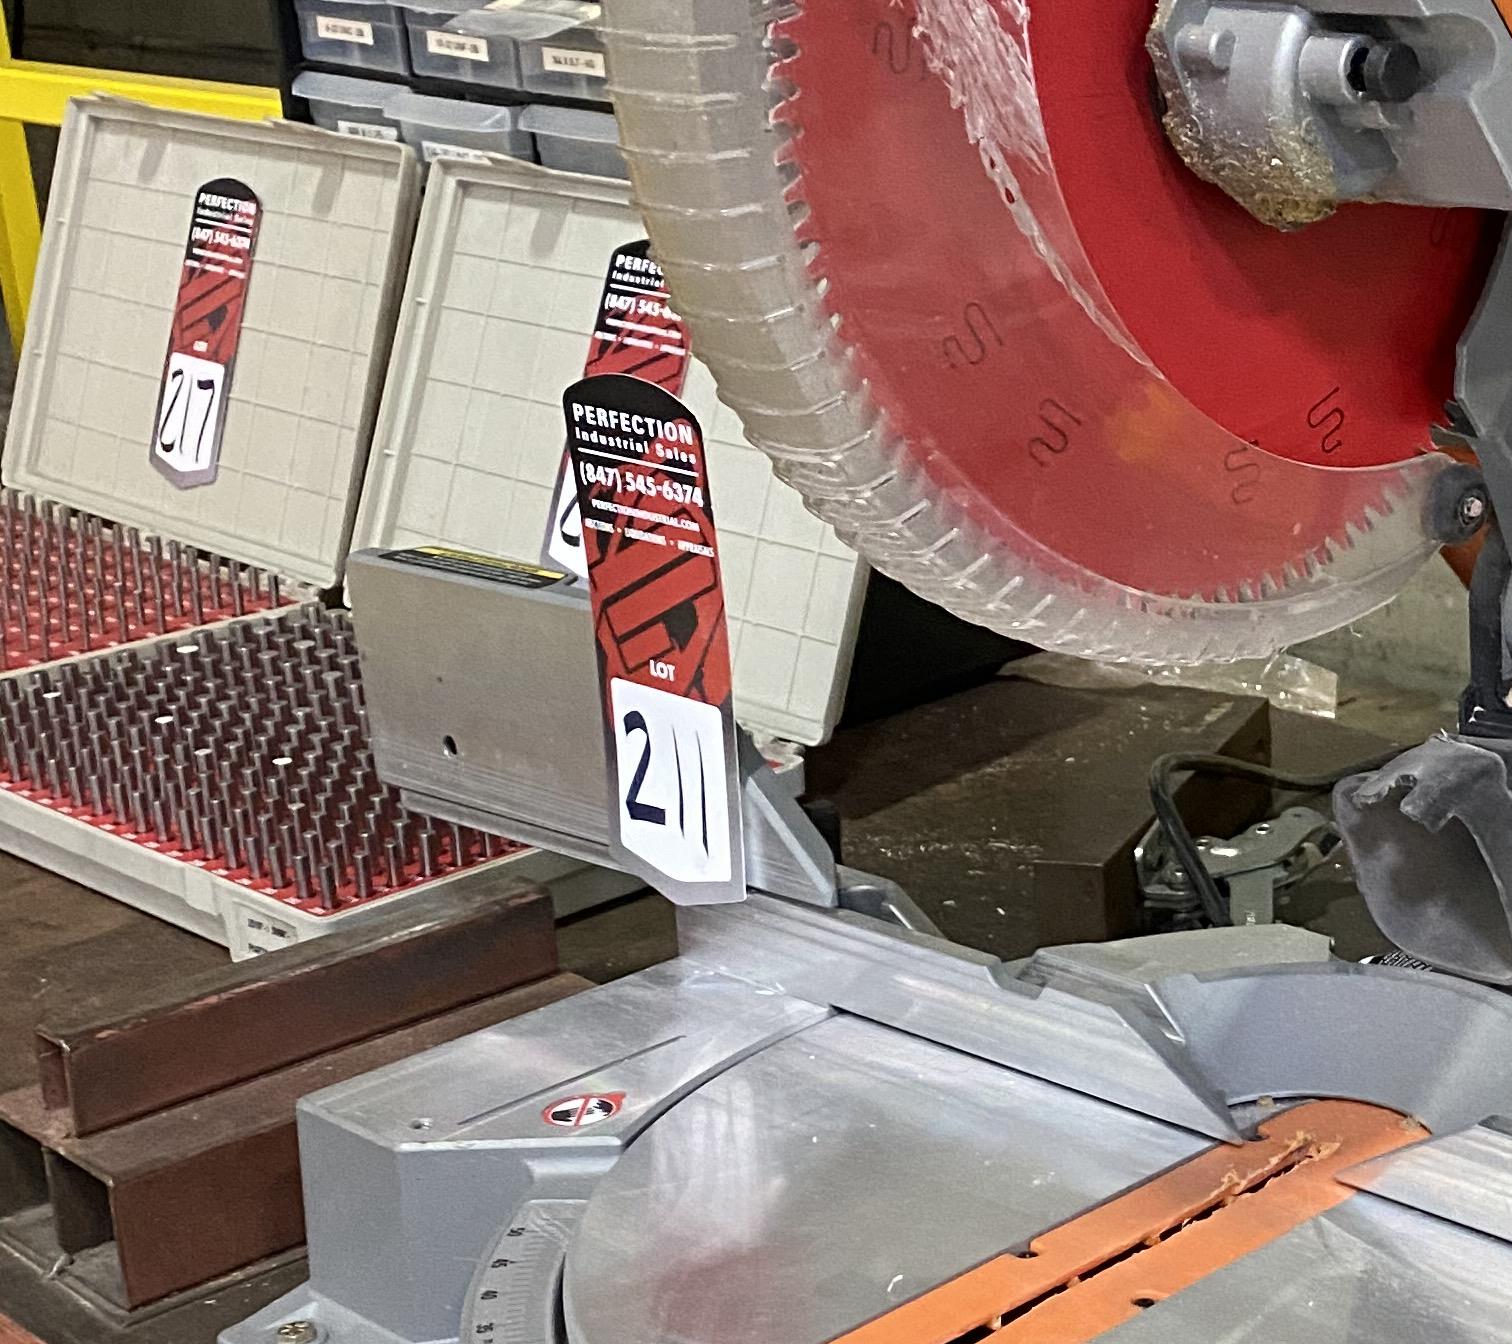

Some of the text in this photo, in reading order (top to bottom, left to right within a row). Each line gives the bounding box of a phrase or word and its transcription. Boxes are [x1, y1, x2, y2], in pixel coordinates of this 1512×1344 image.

[616, 254, 664, 276] PERFEC
[572, 403, 693, 445] PERFECTION
[575, 427, 697, 464] Industrial Sales
[580, 461, 704, 508] (847) 545-6374
[649, 659, 676, 682] LOT
[623, 710, 710, 858] 211
